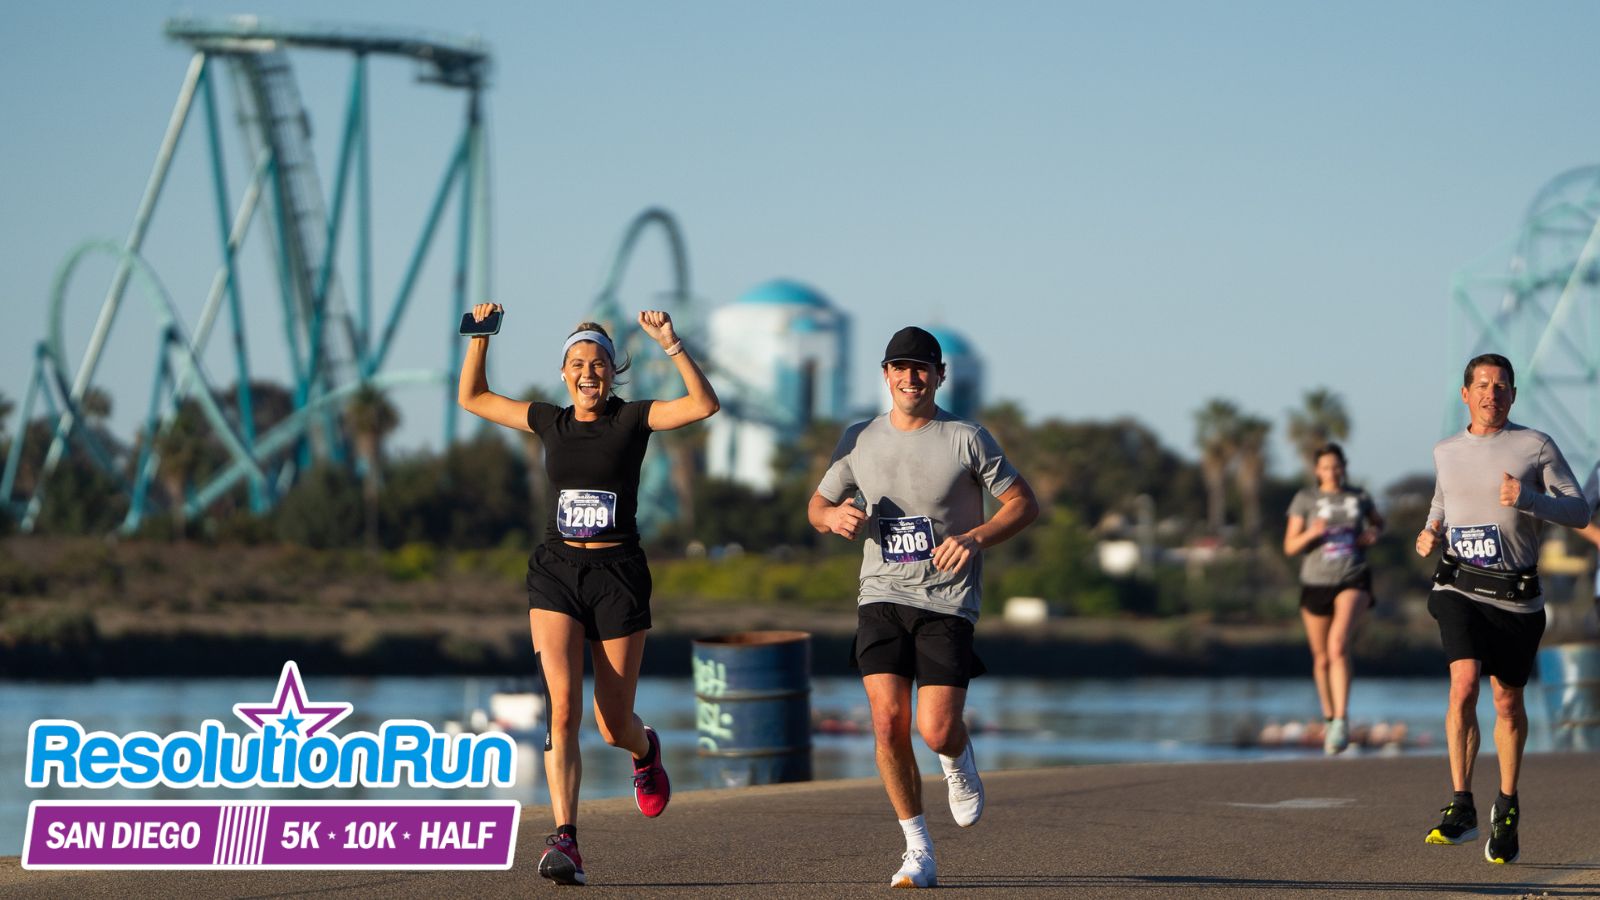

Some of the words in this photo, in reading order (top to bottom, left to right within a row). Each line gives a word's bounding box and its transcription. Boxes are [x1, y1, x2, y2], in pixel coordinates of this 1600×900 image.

[564, 507, 608, 528] 1209
[886, 532, 927, 553] 1208
[1455, 539, 1496, 558] 1346
